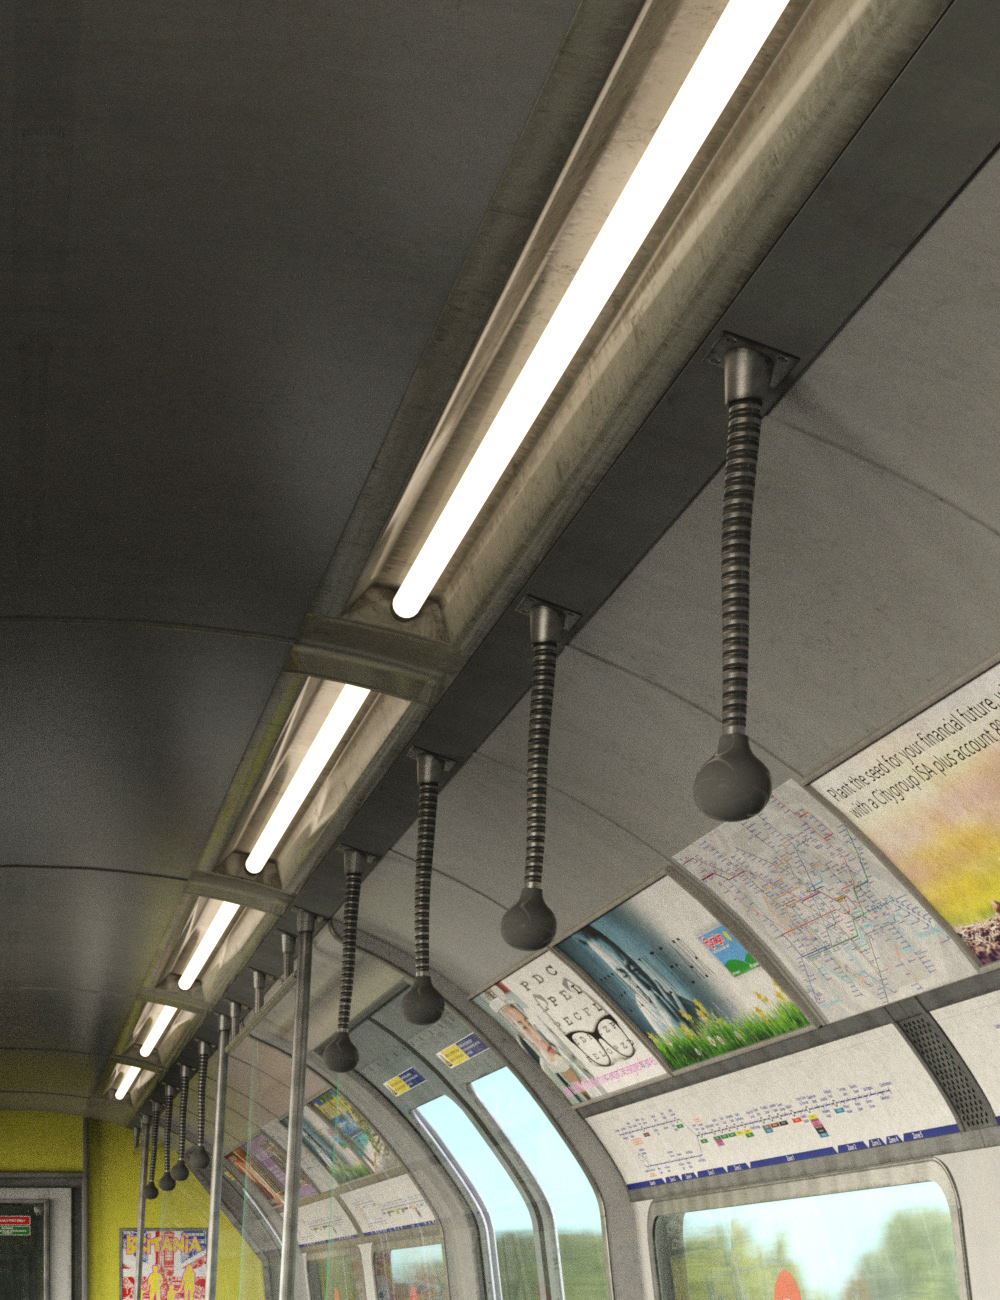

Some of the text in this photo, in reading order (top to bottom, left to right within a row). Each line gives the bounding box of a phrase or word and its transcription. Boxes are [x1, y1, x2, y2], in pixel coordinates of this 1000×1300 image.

[953, 729, 999, 761] account
[826, 782, 857, 802] Plant
[848, 774, 871, 790] the
[865, 759, 890, 782] seed
[881, 753, 904, 770] for
[898, 741, 926, 765] your
[917, 713, 967, 748] financial
[933, 755, 957, 777] plus
[912, 763, 938, 782] ISA
[872, 775, 922, 804] Citygroup
[850, 801, 873, 818] with
[868, 799, 879, 809] a
